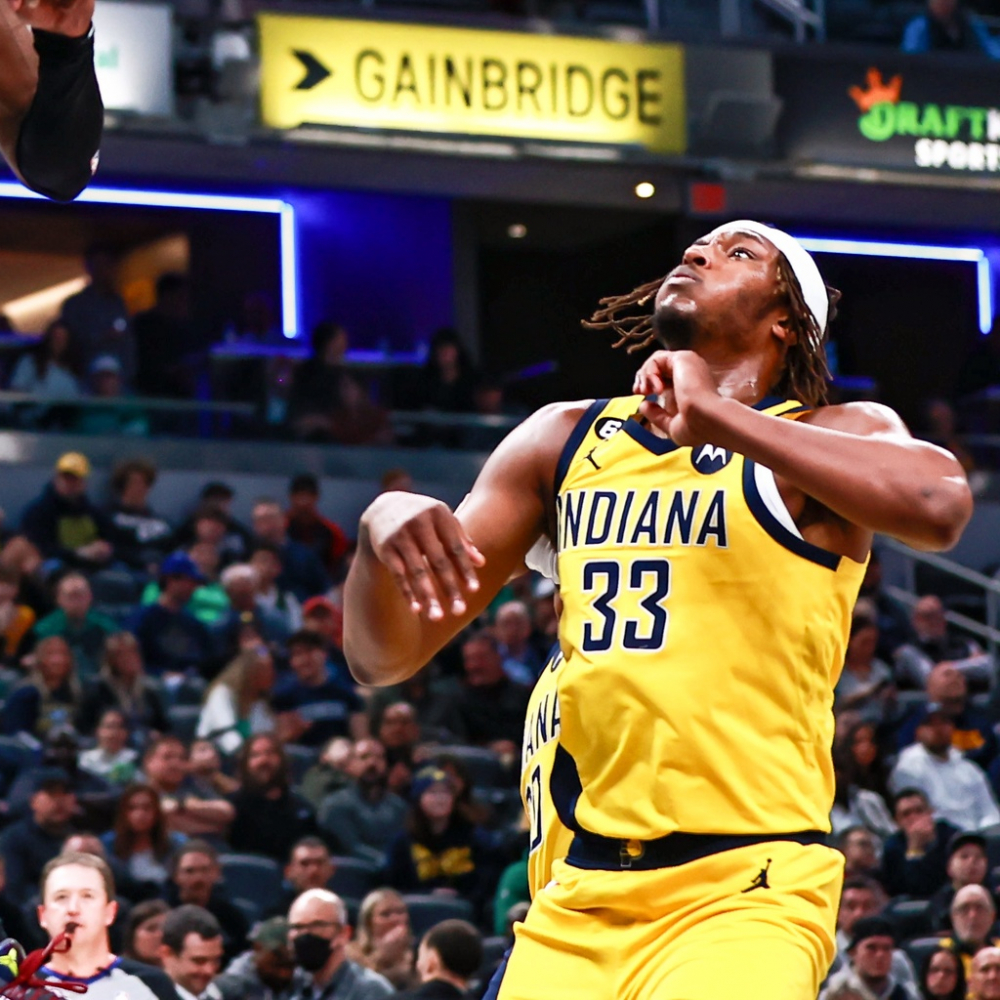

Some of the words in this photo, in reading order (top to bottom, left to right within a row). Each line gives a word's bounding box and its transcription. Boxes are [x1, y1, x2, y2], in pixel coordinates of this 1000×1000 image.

[353, 48, 663, 126] GAINBRIDGE
[598, 419, 624, 439] 6
[582, 559, 670, 652] 33
